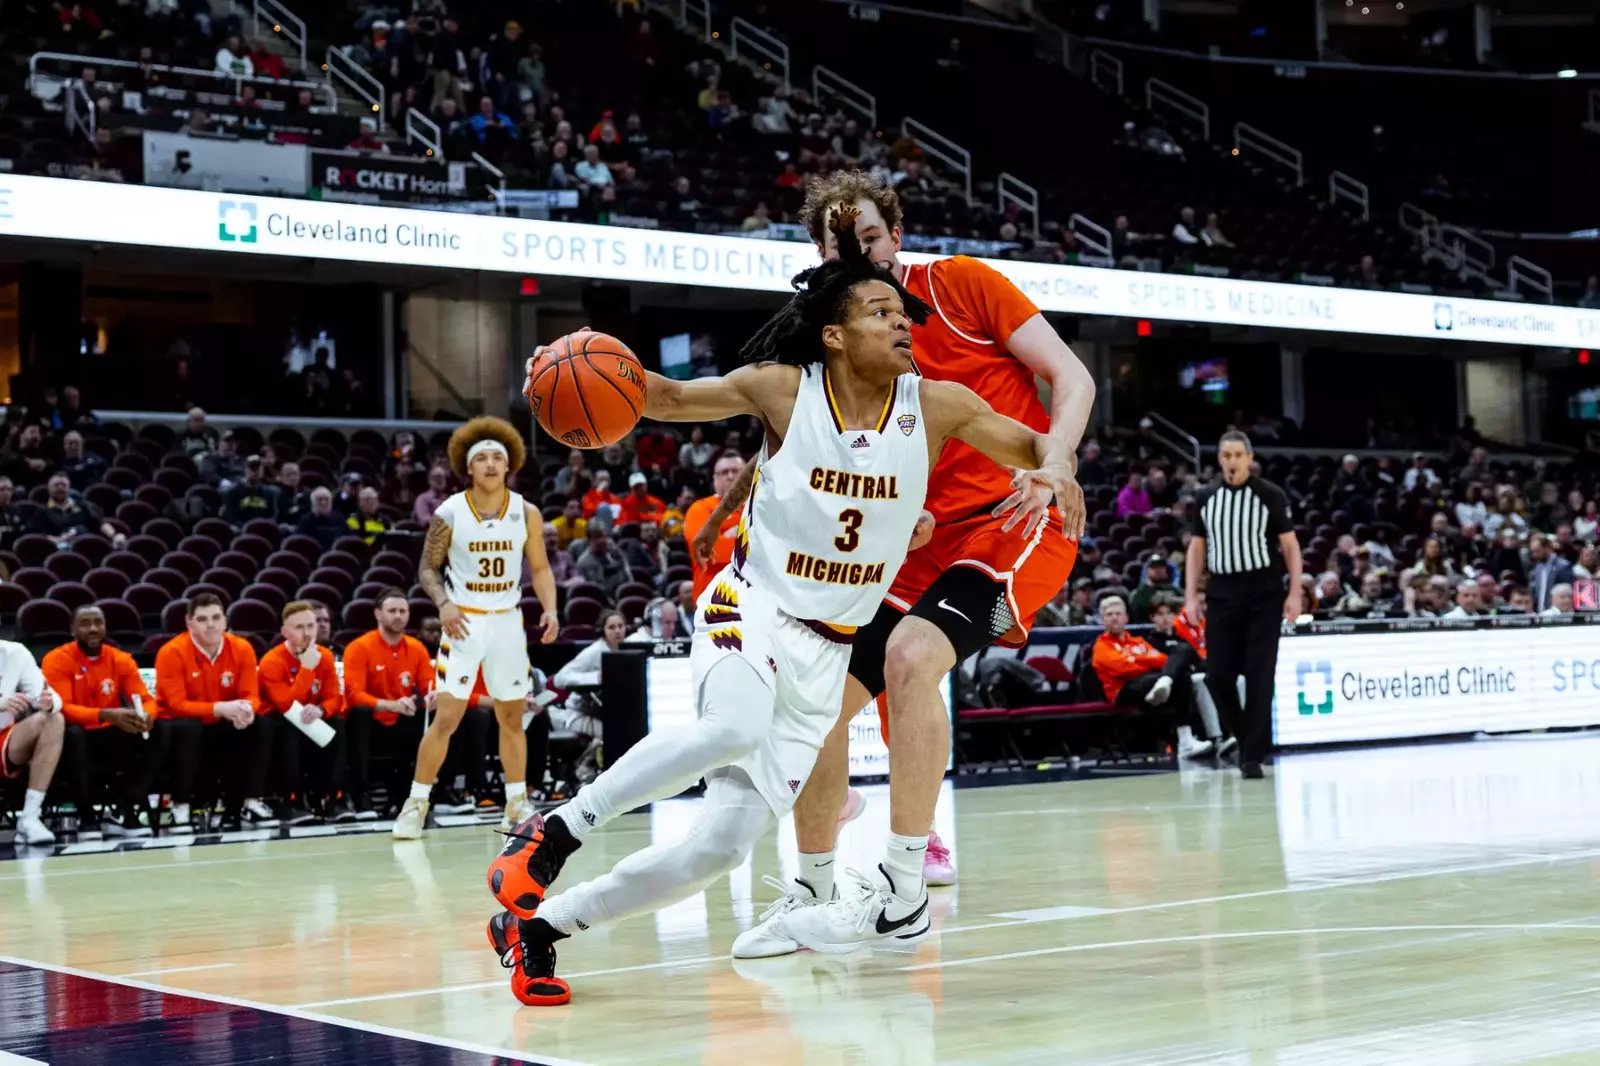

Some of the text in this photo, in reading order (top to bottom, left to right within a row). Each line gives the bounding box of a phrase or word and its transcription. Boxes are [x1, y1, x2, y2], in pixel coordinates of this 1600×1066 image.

[325, 166, 408, 191] ROCKET
[267, 213, 462, 250] Cleveland Clinic
[502, 231, 795, 279] SPORTS MEDICINE
[1128, 282, 1335, 320] SPORTS MEDICINE
[809, 466, 898, 499] CENTRAL
[468, 540, 514, 552] CENTRAL
[834, 508, 864, 552] 3
[478, 557, 505, 578] 30
[785, 551, 886, 586] MICHIGAN
[465, 580, 515, 592] MICHIGAN
[653, 642, 684, 655] anc
[1341, 666, 1516, 701] Cleveland Clinic
[1552, 659, 1600, 692] SPO
[849, 724, 881, 741] Clini
